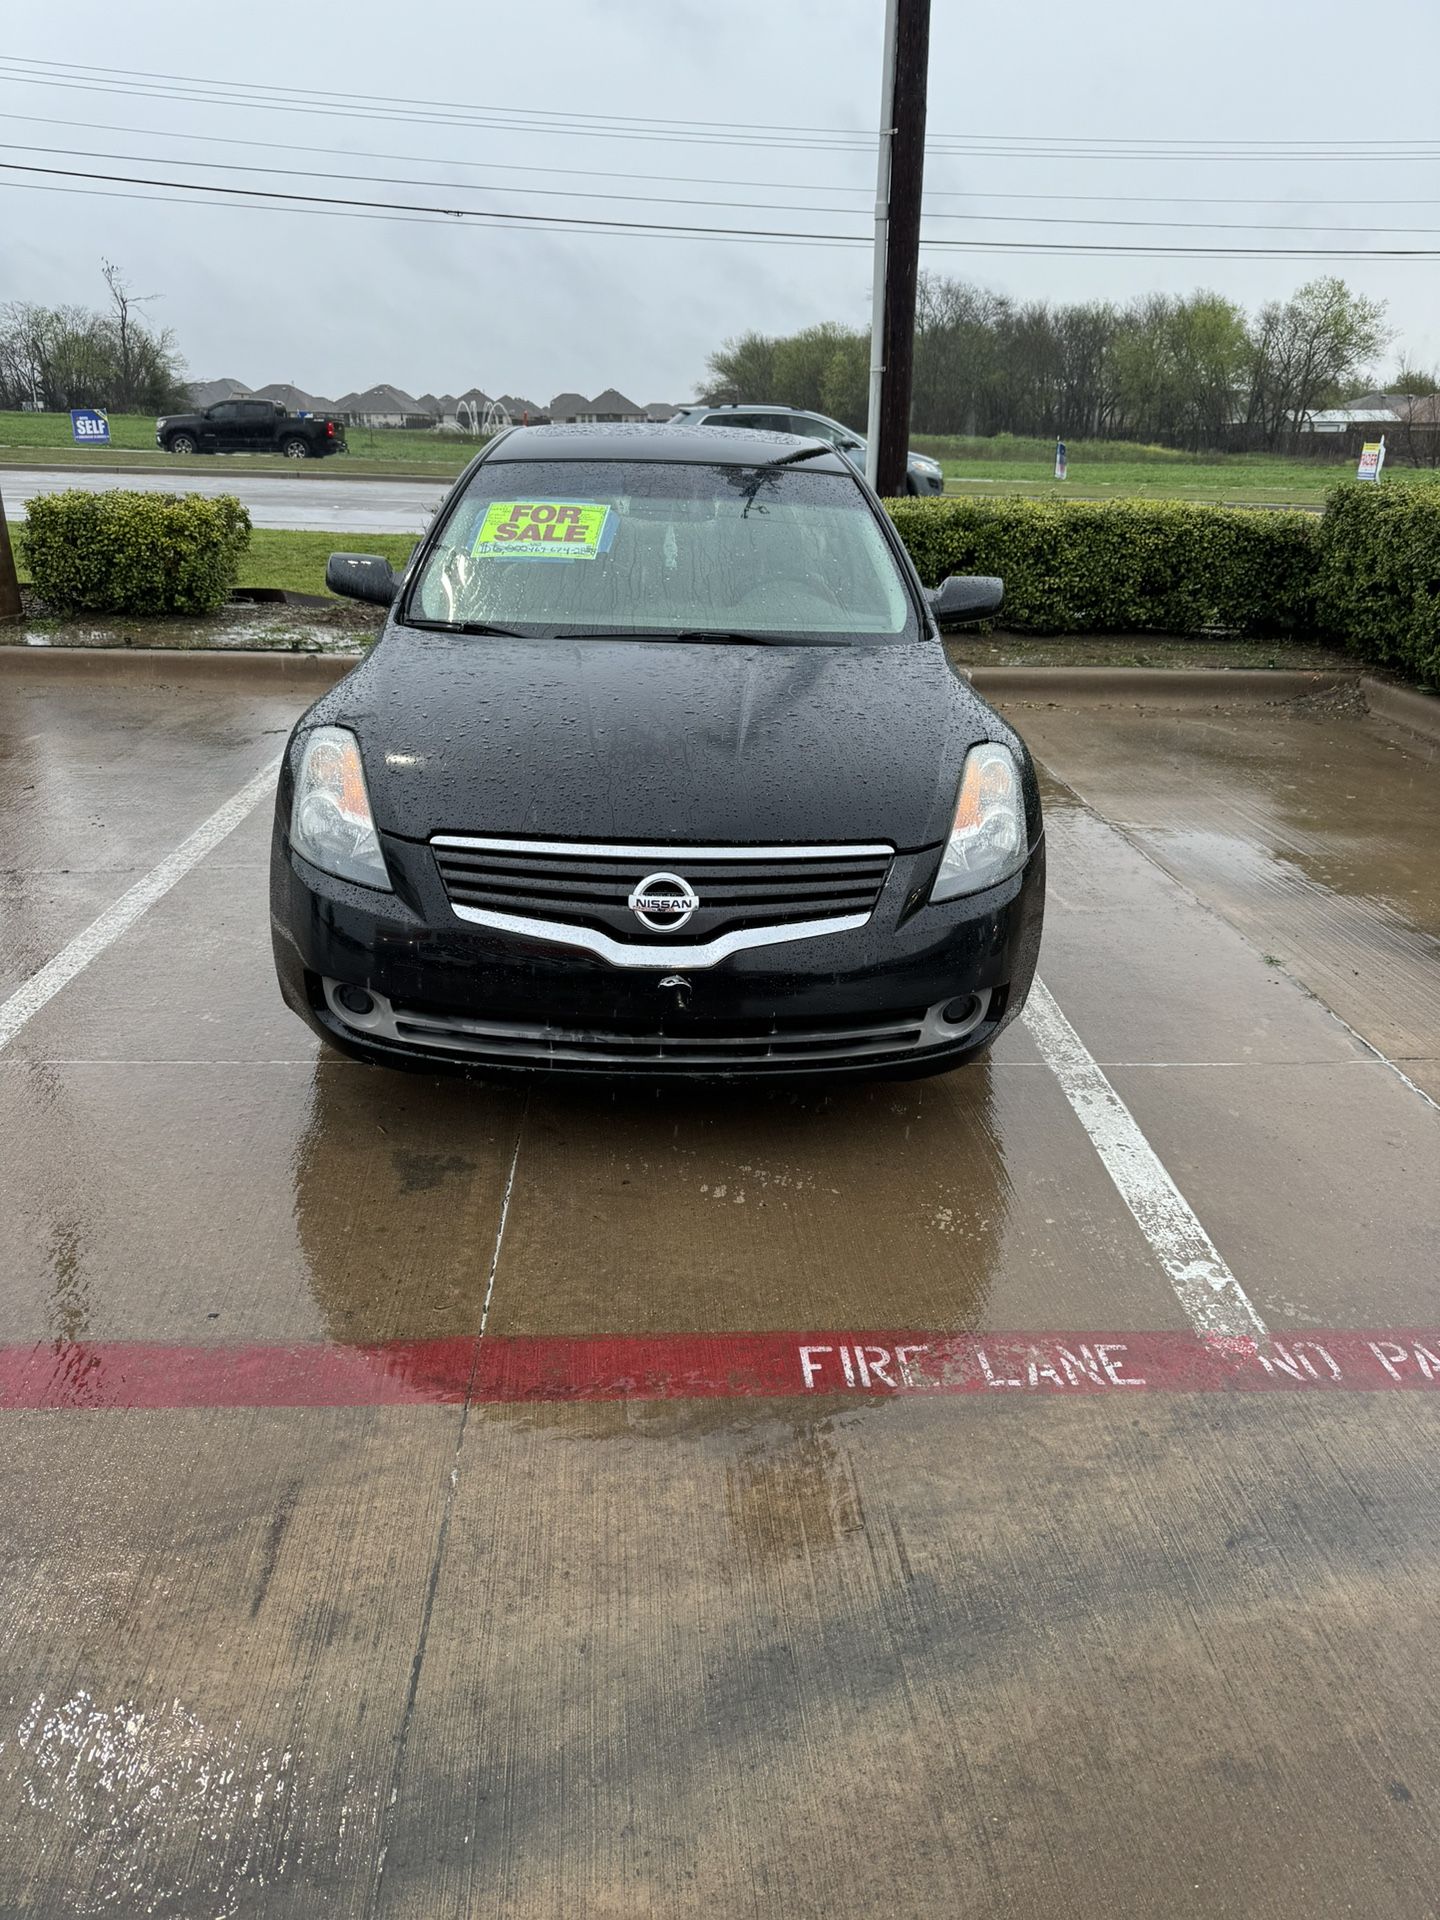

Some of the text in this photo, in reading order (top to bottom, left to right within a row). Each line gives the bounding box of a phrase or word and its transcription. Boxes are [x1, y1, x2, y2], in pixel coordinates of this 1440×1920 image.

[76, 420, 105, 435] SELF
[509, 505, 582, 524] FOR
[494, 523, 589, 543] SALE
[635, 898, 692, 909] NISSAN
[799, 1345, 940, 1388] FIRE
[972, 1343, 1147, 1387] LANE
[1258, 1341, 1342, 1382] NO
